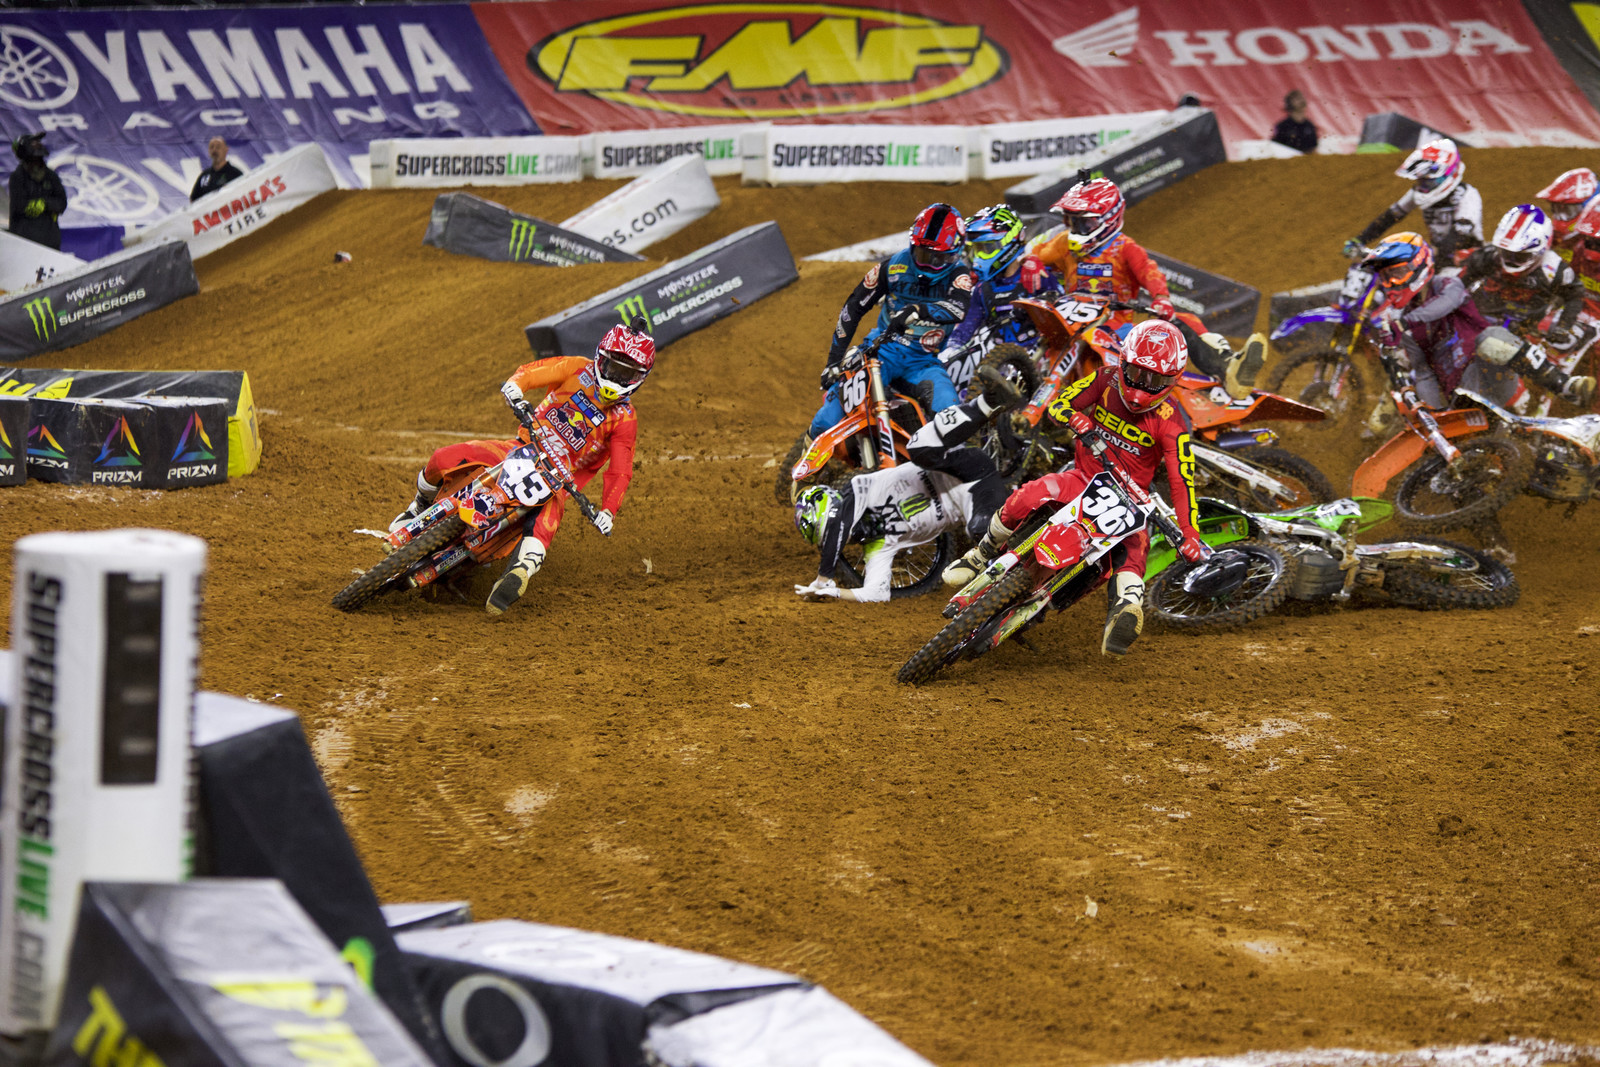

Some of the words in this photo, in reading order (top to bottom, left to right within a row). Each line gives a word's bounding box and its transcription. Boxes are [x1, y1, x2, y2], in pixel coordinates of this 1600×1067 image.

[557, 18, 983, 91] FMF
[1155, 20, 1531, 66] HONDA
[67, 24, 472, 102] YAMAHA
[39, 101, 462, 132] RACING
[395, 153, 579, 177] SUPERCROSSLIVE.COM
[773, 142, 963, 168] SUPERCROSSLIVE.COM
[192, 175, 286, 236] AMERICA'S
[224, 207, 266, 235] TIRE
[66, 274, 126, 303] MONSTER
[657, 264, 719, 299] MONSTER
[59, 287, 146, 327] SUPERCROSS
[652, 276, 743, 326] SUPERCROSS
[1053, 301, 1102, 323] 45
[576, 390, 605, 422] GoPro
[843, 369, 866, 413] 56
[1094, 404, 1155, 448] GEICO
[1156, 401, 1174, 421] 36
[546, 408, 567, 433] Red
[561, 426, 587, 451] Bull
[1095, 425, 1140, 456] HONDA
[26, 457, 69, 470] RIZM
[93, 470, 143, 483] PRIZM
[167, 464, 217, 480] PRIZM
[540, 440, 572, 480] RENTHAL
[502, 458, 552, 506] 43
[1082, 486, 1135, 535] 36
[1037, 542, 1061, 565] GEICO
